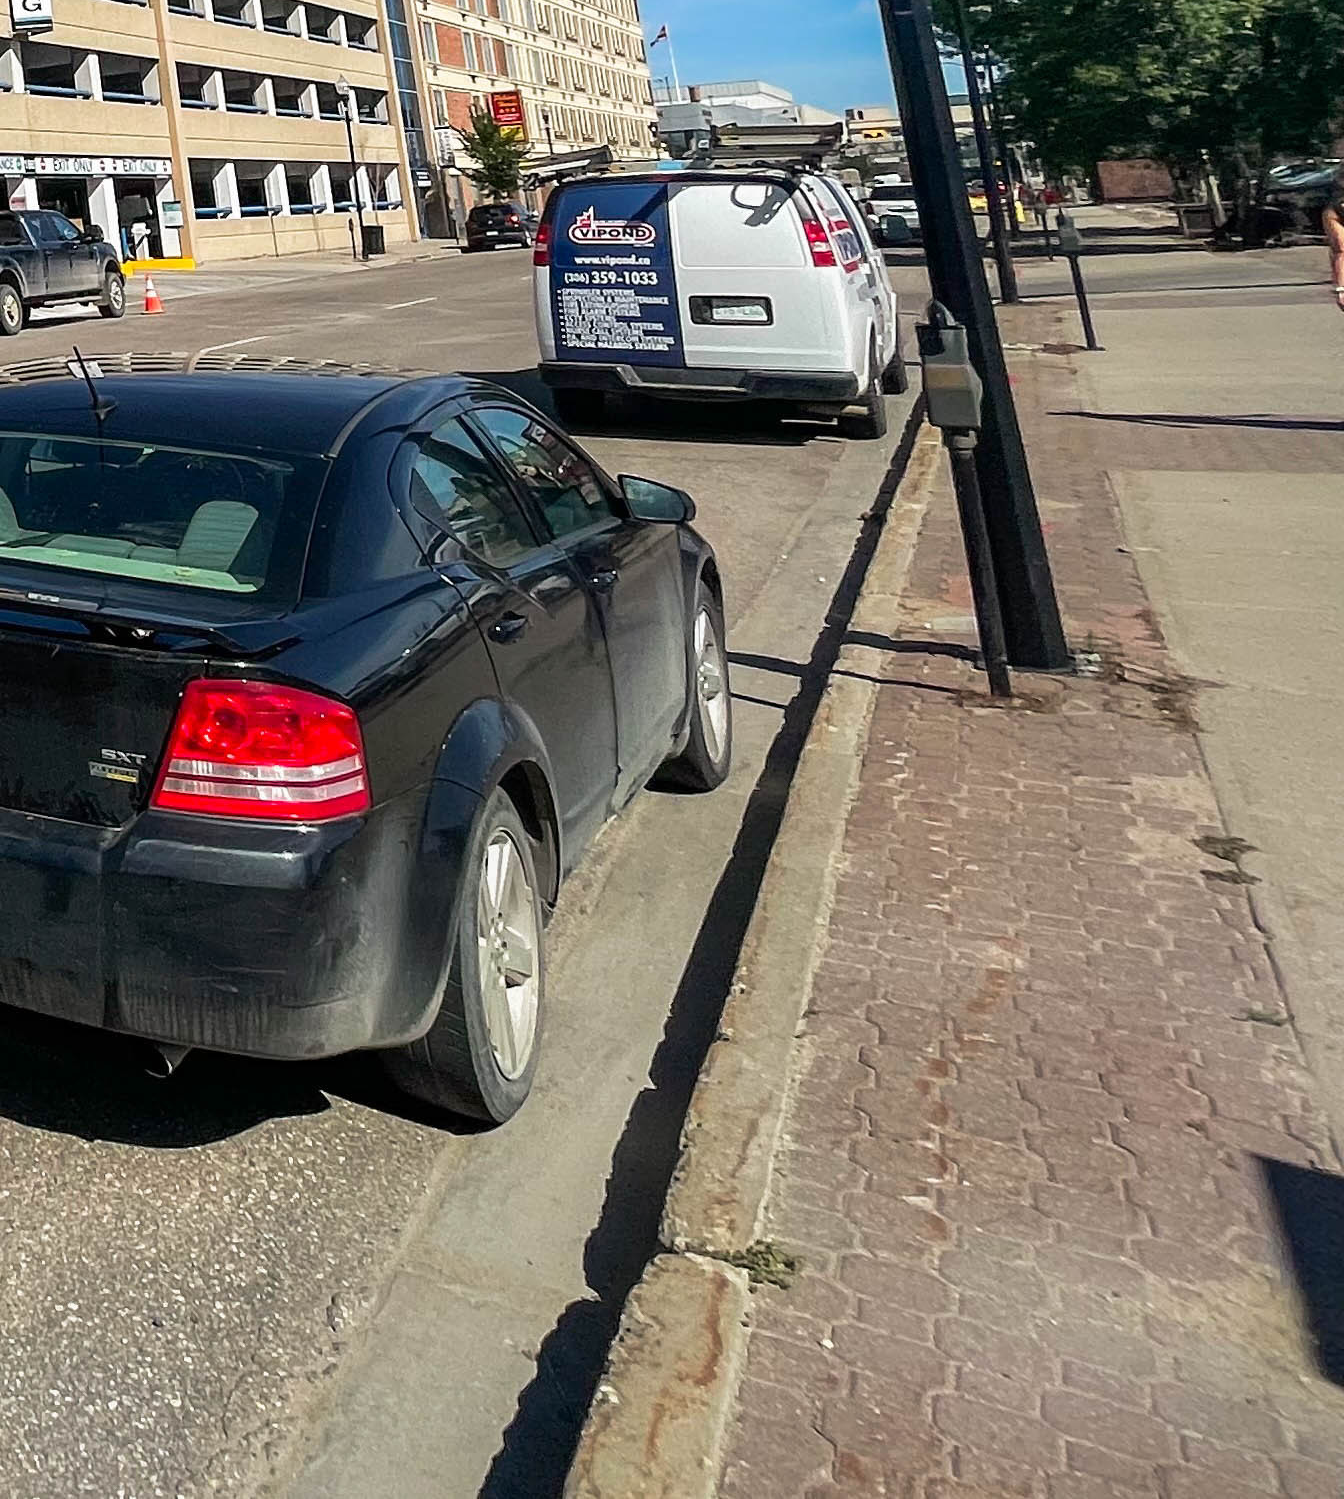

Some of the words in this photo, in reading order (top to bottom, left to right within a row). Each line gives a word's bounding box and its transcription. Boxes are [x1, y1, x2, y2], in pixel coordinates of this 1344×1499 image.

[53, 158, 70, 172] EXIT
[73, 158, 93, 172] ONLY
[123, 159, 138, 172] EXIT
[140, 159, 157, 172] ONLY
[578, 228, 647, 238] VIPOND
[574, 254, 651, 267] www.vipond.ca
[564, 272, 590, 285] (306)
[591, 271, 659, 285] 359-1033
[101, 748, 147, 766] SXT
